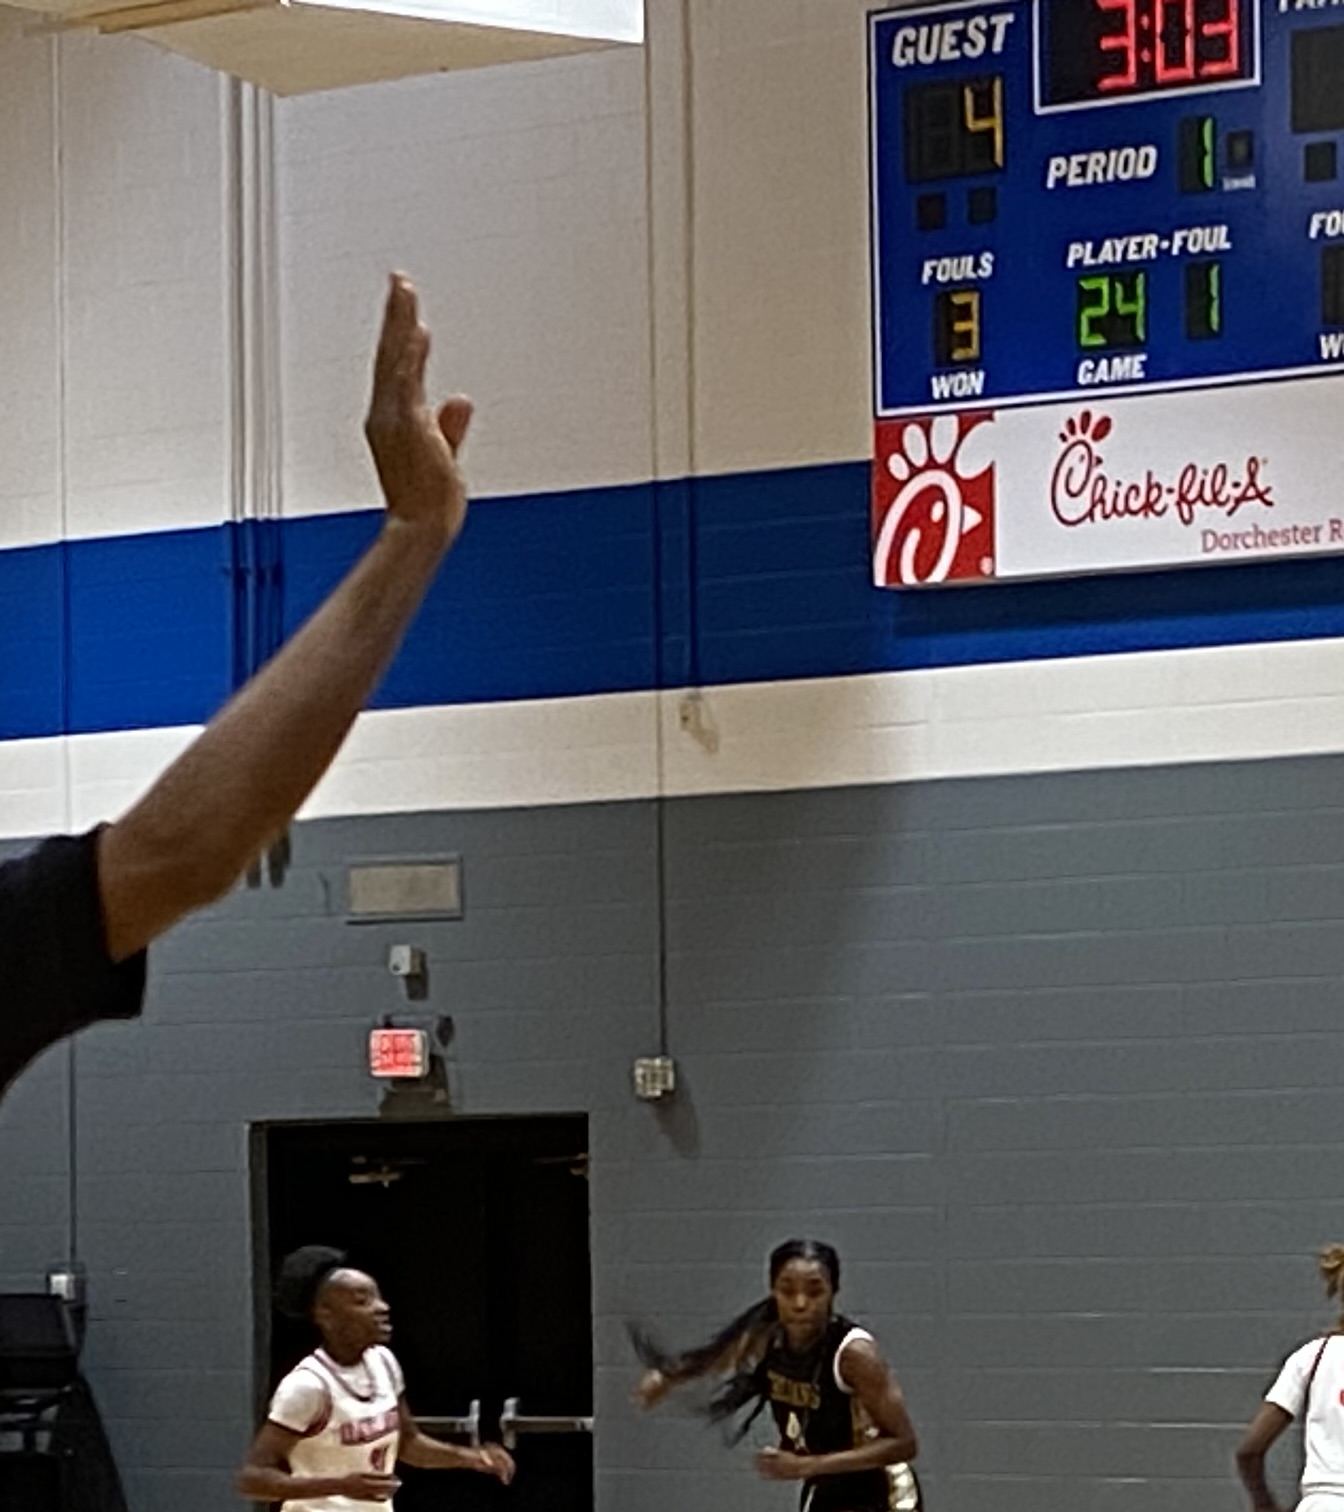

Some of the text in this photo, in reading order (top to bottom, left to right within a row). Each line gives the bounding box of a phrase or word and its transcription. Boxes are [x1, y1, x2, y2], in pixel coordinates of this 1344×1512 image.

[892, 14, 1016, 67] GUEST
[963, 77, 1004, 168] 4
[1047, 146, 1157, 189] PERIOD
[922, 253, 994, 285] FOULS
[951, 291, 981, 361] 3
[1079, 272, 1147, 347] 24
[931, 371, 985, 400] WON
[1077, 354, 1148, 386] GAME
[1051, 438, 1275, 527] Chick-fil-A
[1201, 523, 1323, 553] Dorchester
